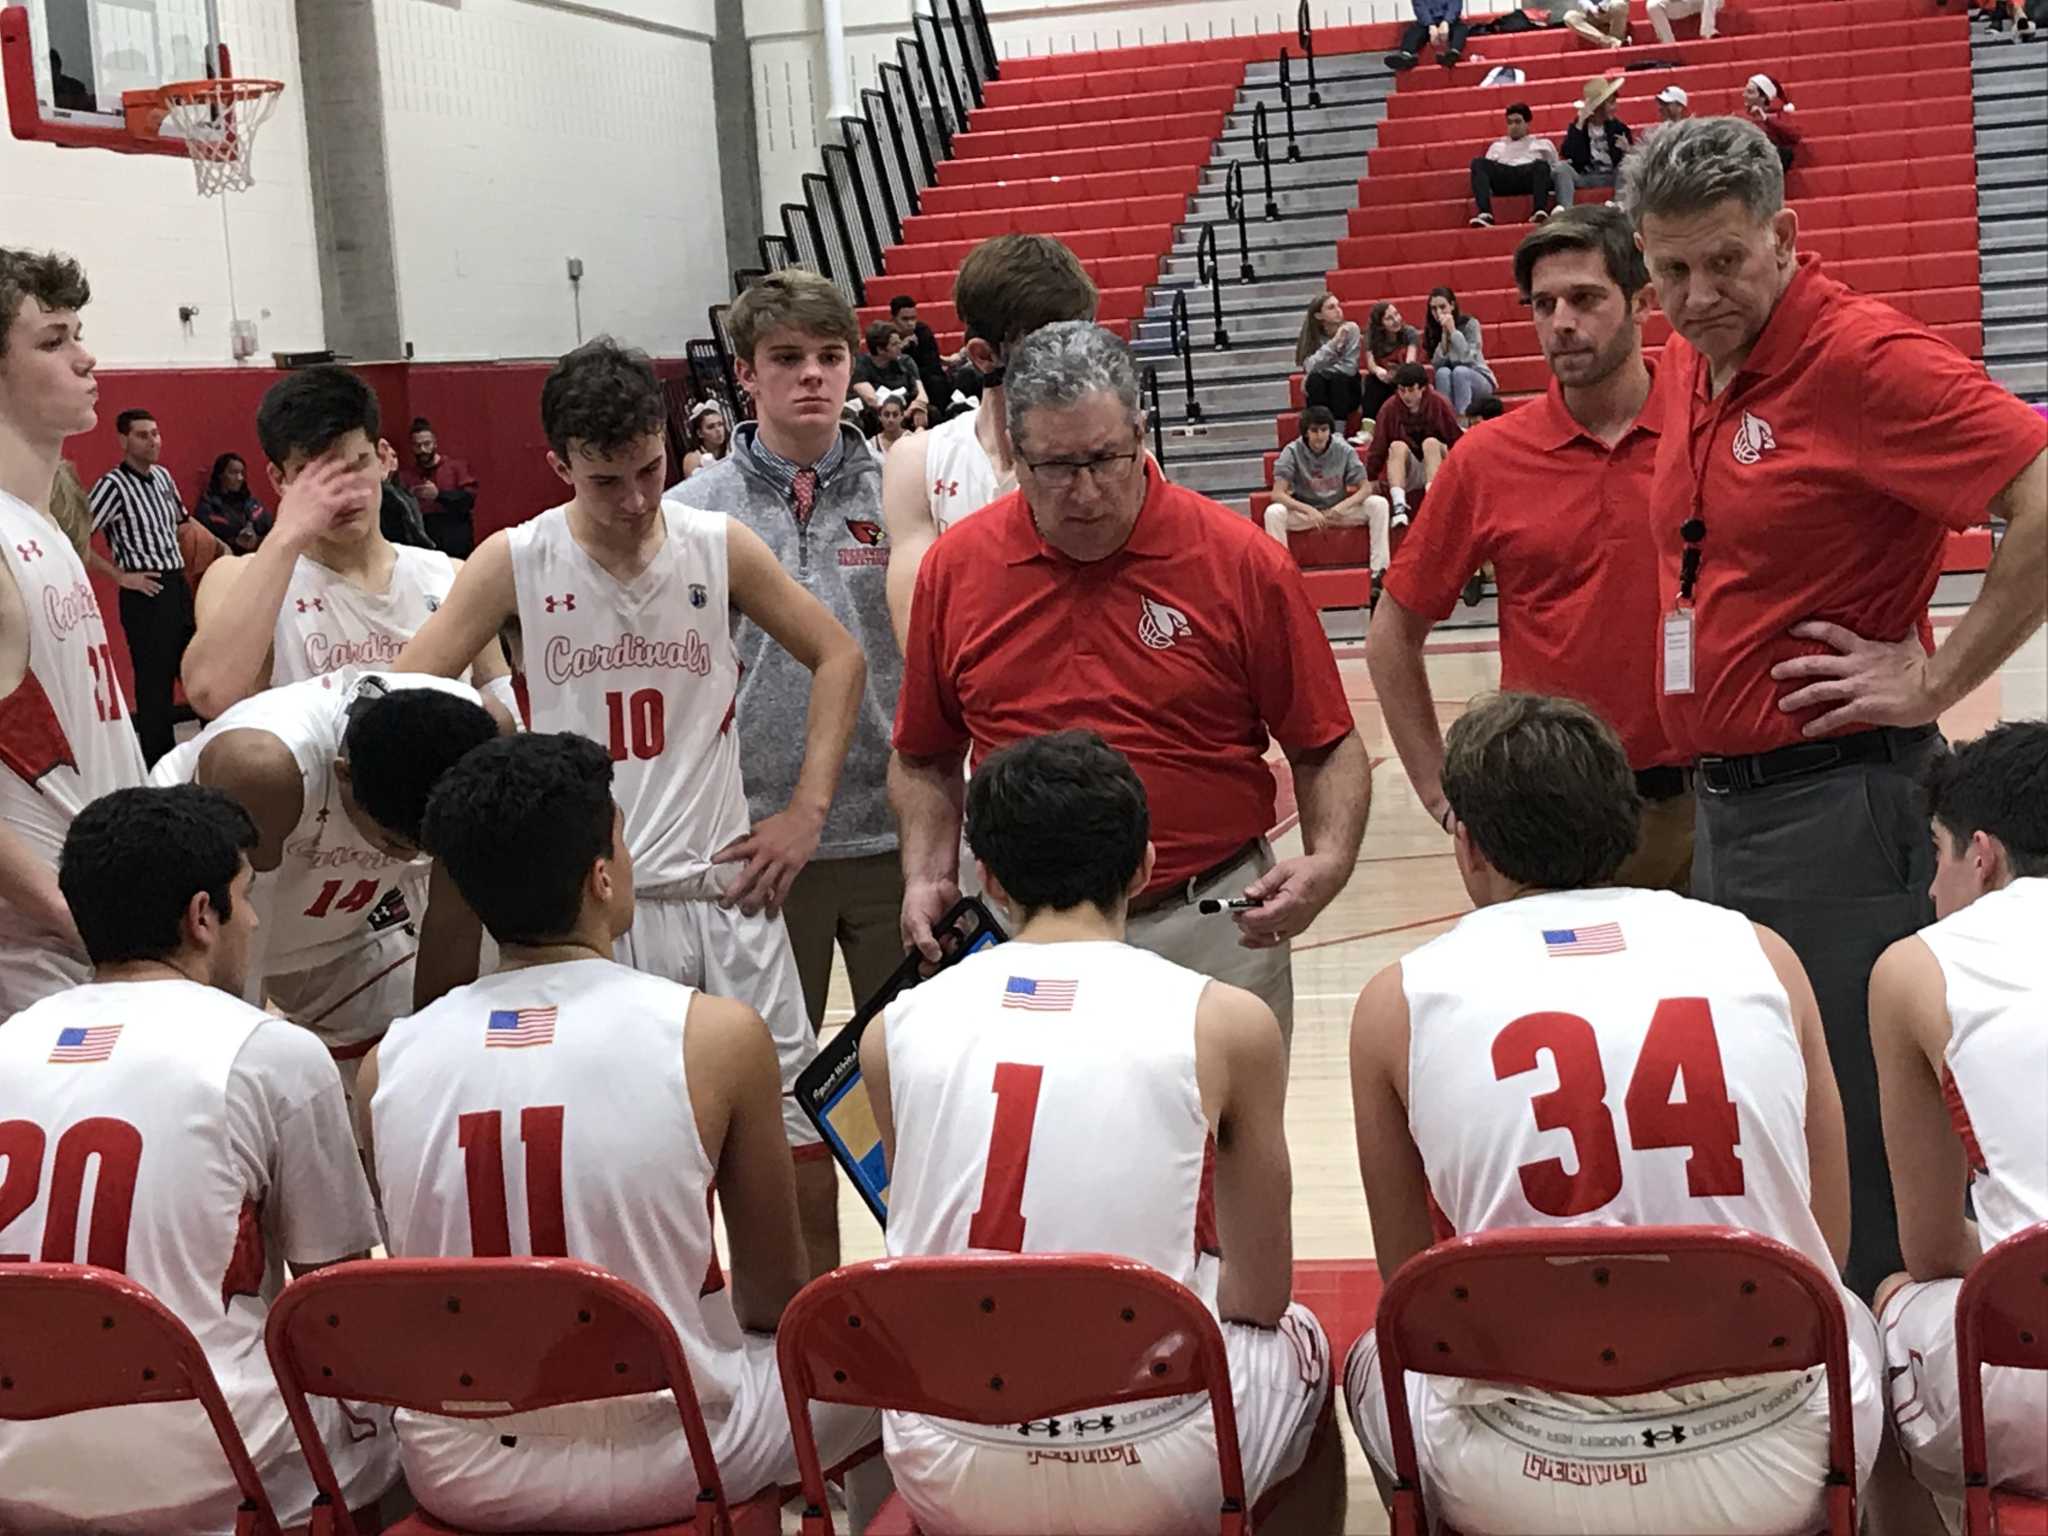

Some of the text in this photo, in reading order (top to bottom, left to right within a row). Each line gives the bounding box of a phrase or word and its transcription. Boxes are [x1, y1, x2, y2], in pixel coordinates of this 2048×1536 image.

[545, 628, 712, 686] Cardinals
[606, 688, 665, 761] 10
[968, 1062, 1044, 1252] 1
[1491, 997, 1745, 1217] 34
[0, 1116, 144, 1275] 20
[459, 1105, 565, 1257] 11
[1579, 1433, 1637, 1448] UNDER
[1691, 1405, 1757, 1436] ARMOUR
